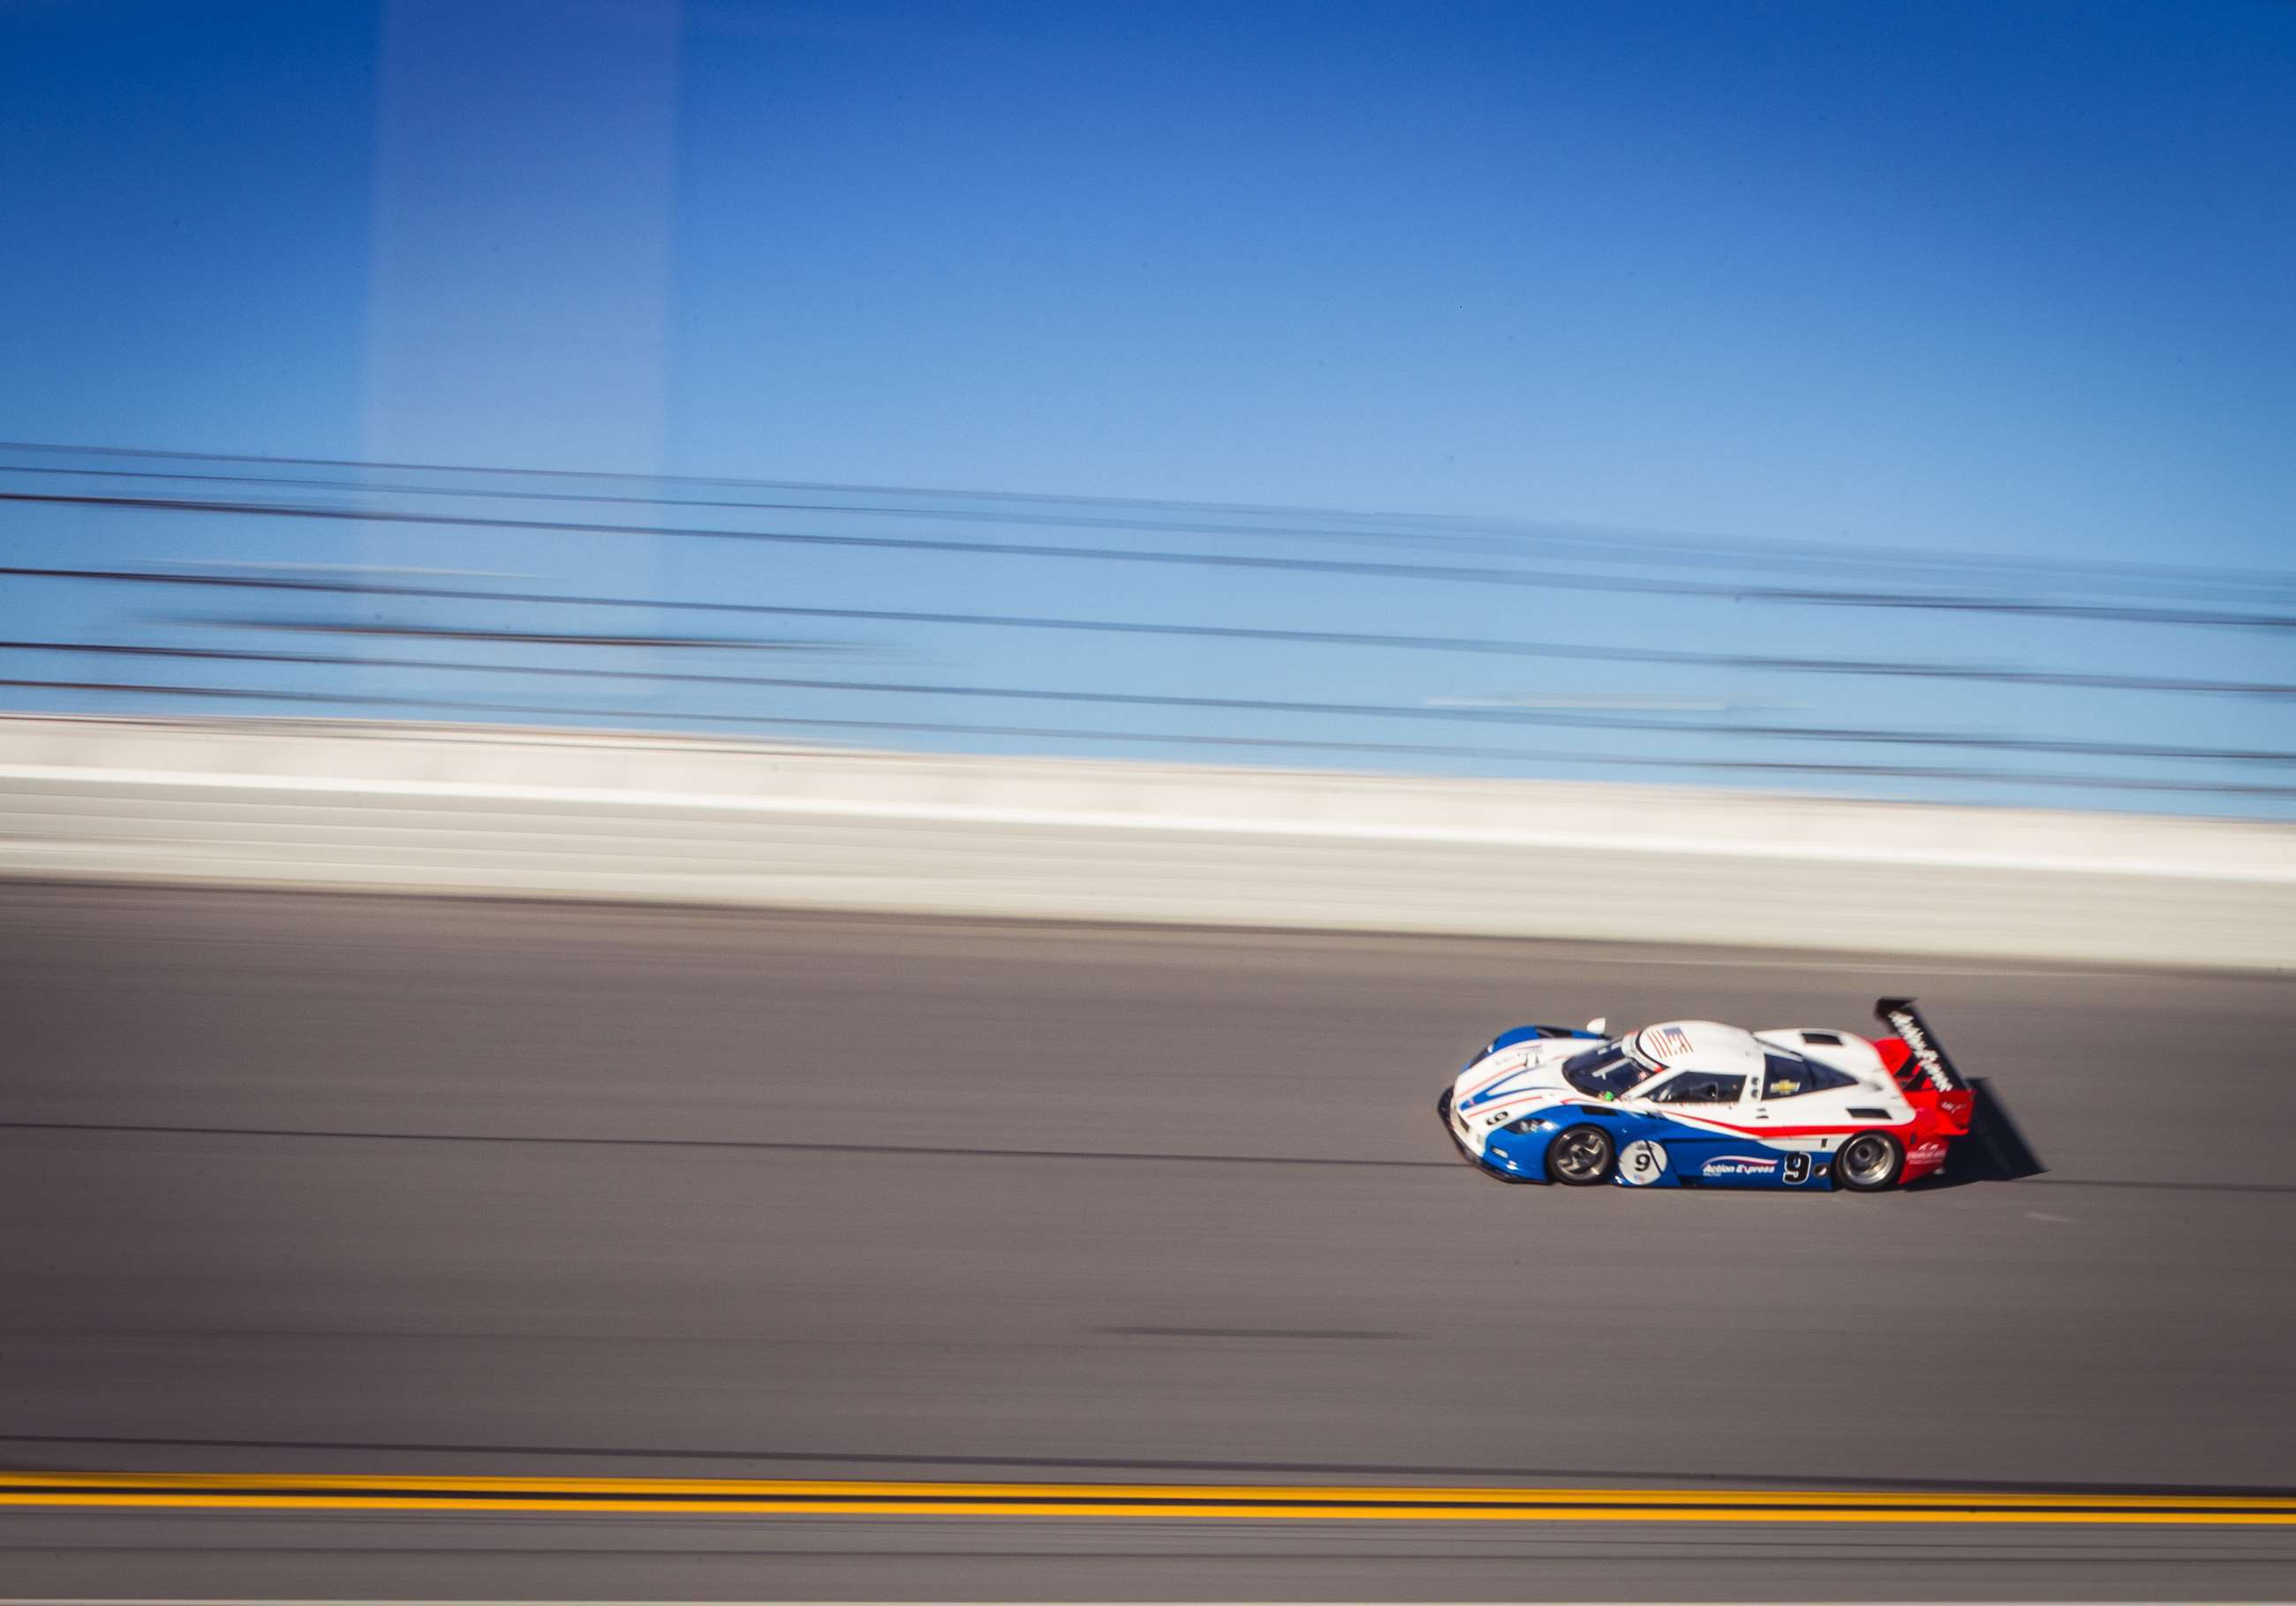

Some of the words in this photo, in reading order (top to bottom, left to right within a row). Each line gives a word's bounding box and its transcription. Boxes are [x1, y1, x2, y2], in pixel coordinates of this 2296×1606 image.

[1634, 1153, 1650, 1172] 9
[1703, 1165, 1735, 1173] Action
[1783, 1151, 1812, 1184] 9
